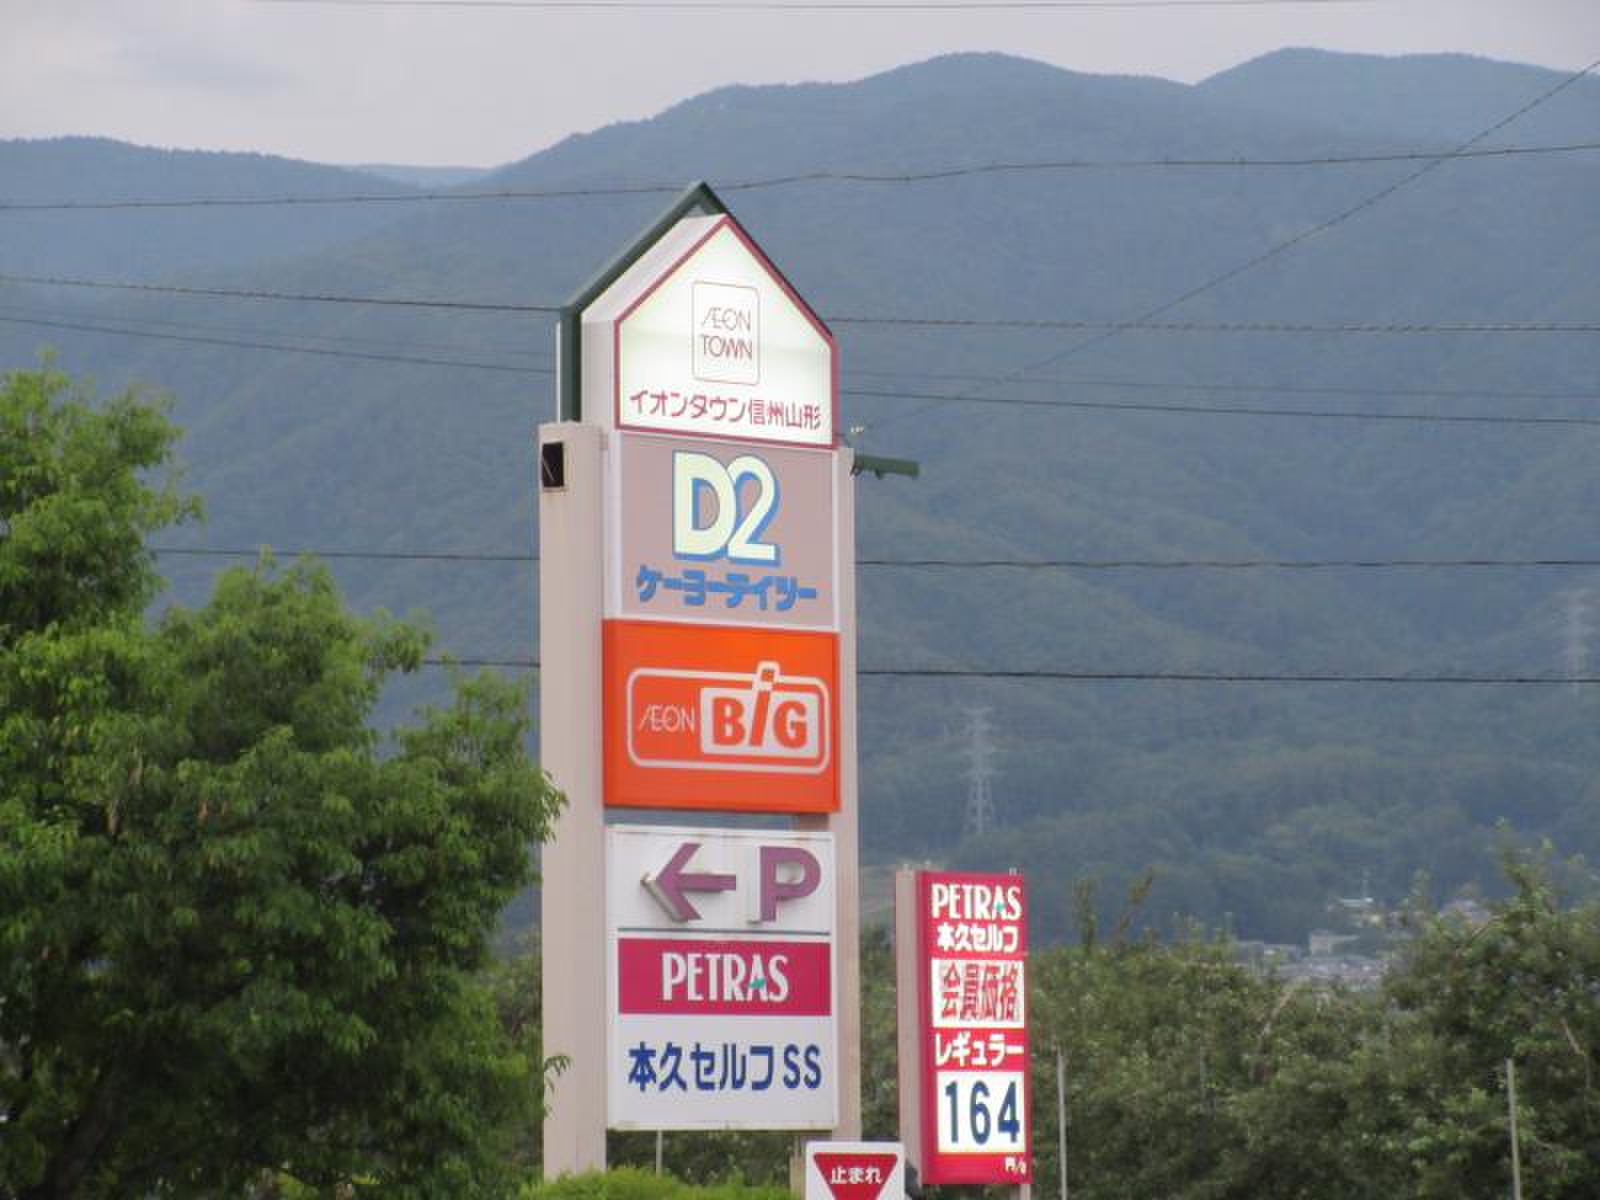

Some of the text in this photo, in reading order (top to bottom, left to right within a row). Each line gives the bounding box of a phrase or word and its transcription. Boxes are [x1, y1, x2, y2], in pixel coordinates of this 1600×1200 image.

[701, 334, 752, 360] TOWN
[630, 390, 822, 430] イオンタウン信州山形
[673, 450, 780, 566] D2
[759, 846, 821, 922] P
[931, 883, 1022, 921] PETRAS
[937, 922, 1018, 954] 本久セルフ
[661, 952, 789, 1003] PETRAS
[934, 1032, 1024, 1067] レギュラー
[945, 1080, 1020, 1144] 164
[831, 1164, 883, 1185] 止まれ
